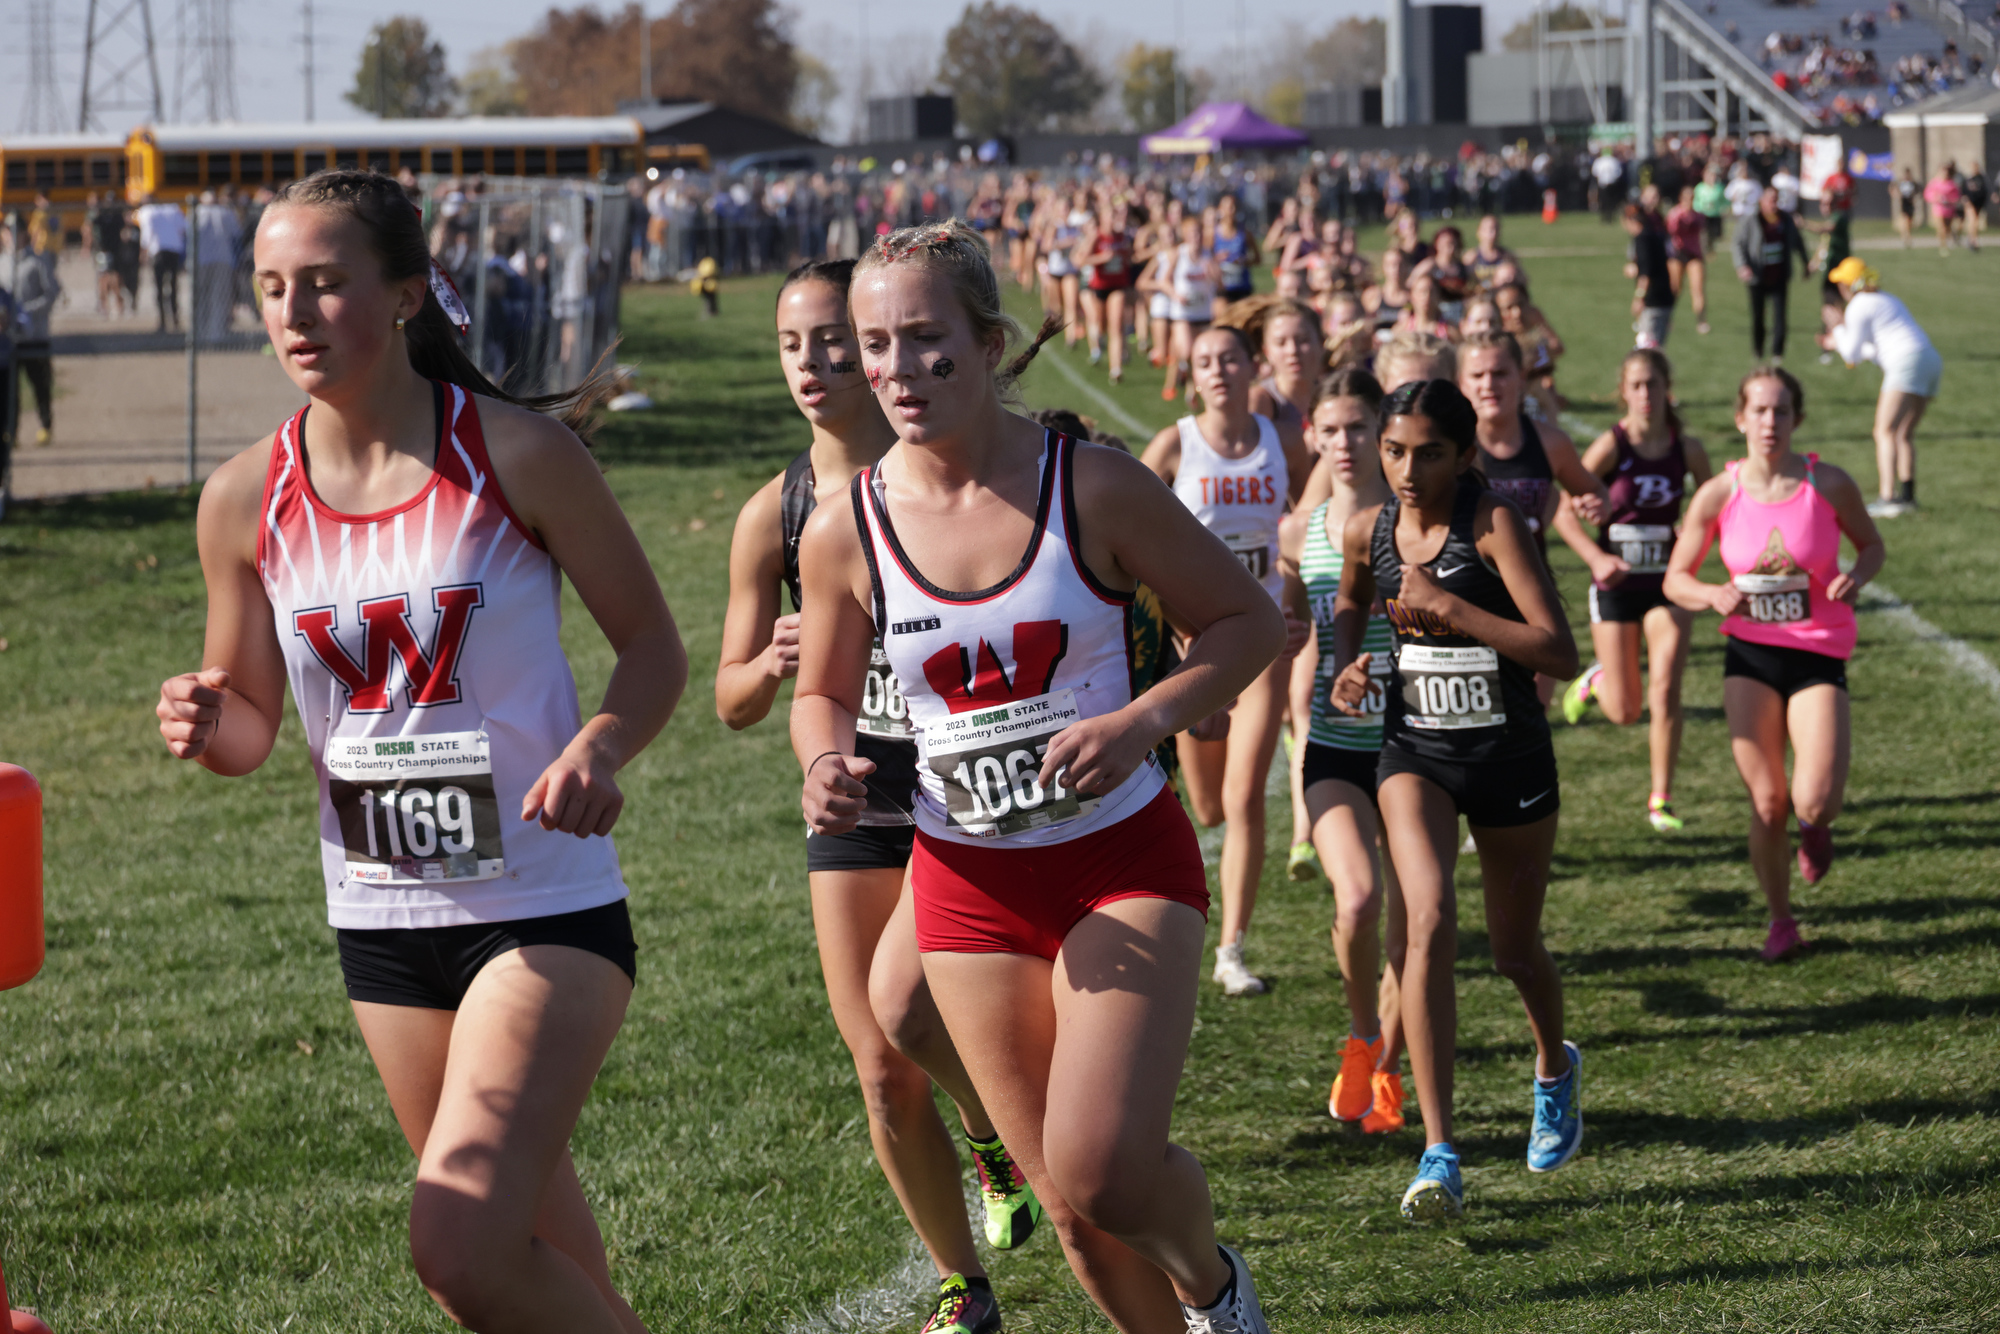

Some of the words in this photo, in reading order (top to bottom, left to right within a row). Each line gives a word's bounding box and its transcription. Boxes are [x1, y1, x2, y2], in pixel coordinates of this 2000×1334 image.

[1199, 476, 1276, 506] TIGERS
[1633, 474, 1683, 509] B
[1747, 592, 1804, 621] 1038
[293, 582, 485, 715] W
[862, 670, 907, 720] 06
[1414, 675, 1492, 715] 1008
[928, 736, 952, 746] Cross
[954, 729, 992, 742] Country
[994, 707, 1076, 734] Championships
[945, 719, 967, 731] 2023
[971, 708, 1010, 727] OHSAA
[1014, 700, 1050, 717] STATE
[330, 759, 352, 769] Cross
[355, 760, 393, 770] Country
[397, 754, 487, 768] Championships
[347, 745, 368, 755] 2023
[375, 741, 415, 756] OHSAA
[421, 740, 459, 752] STATE
[359, 785, 475, 858] 1169
